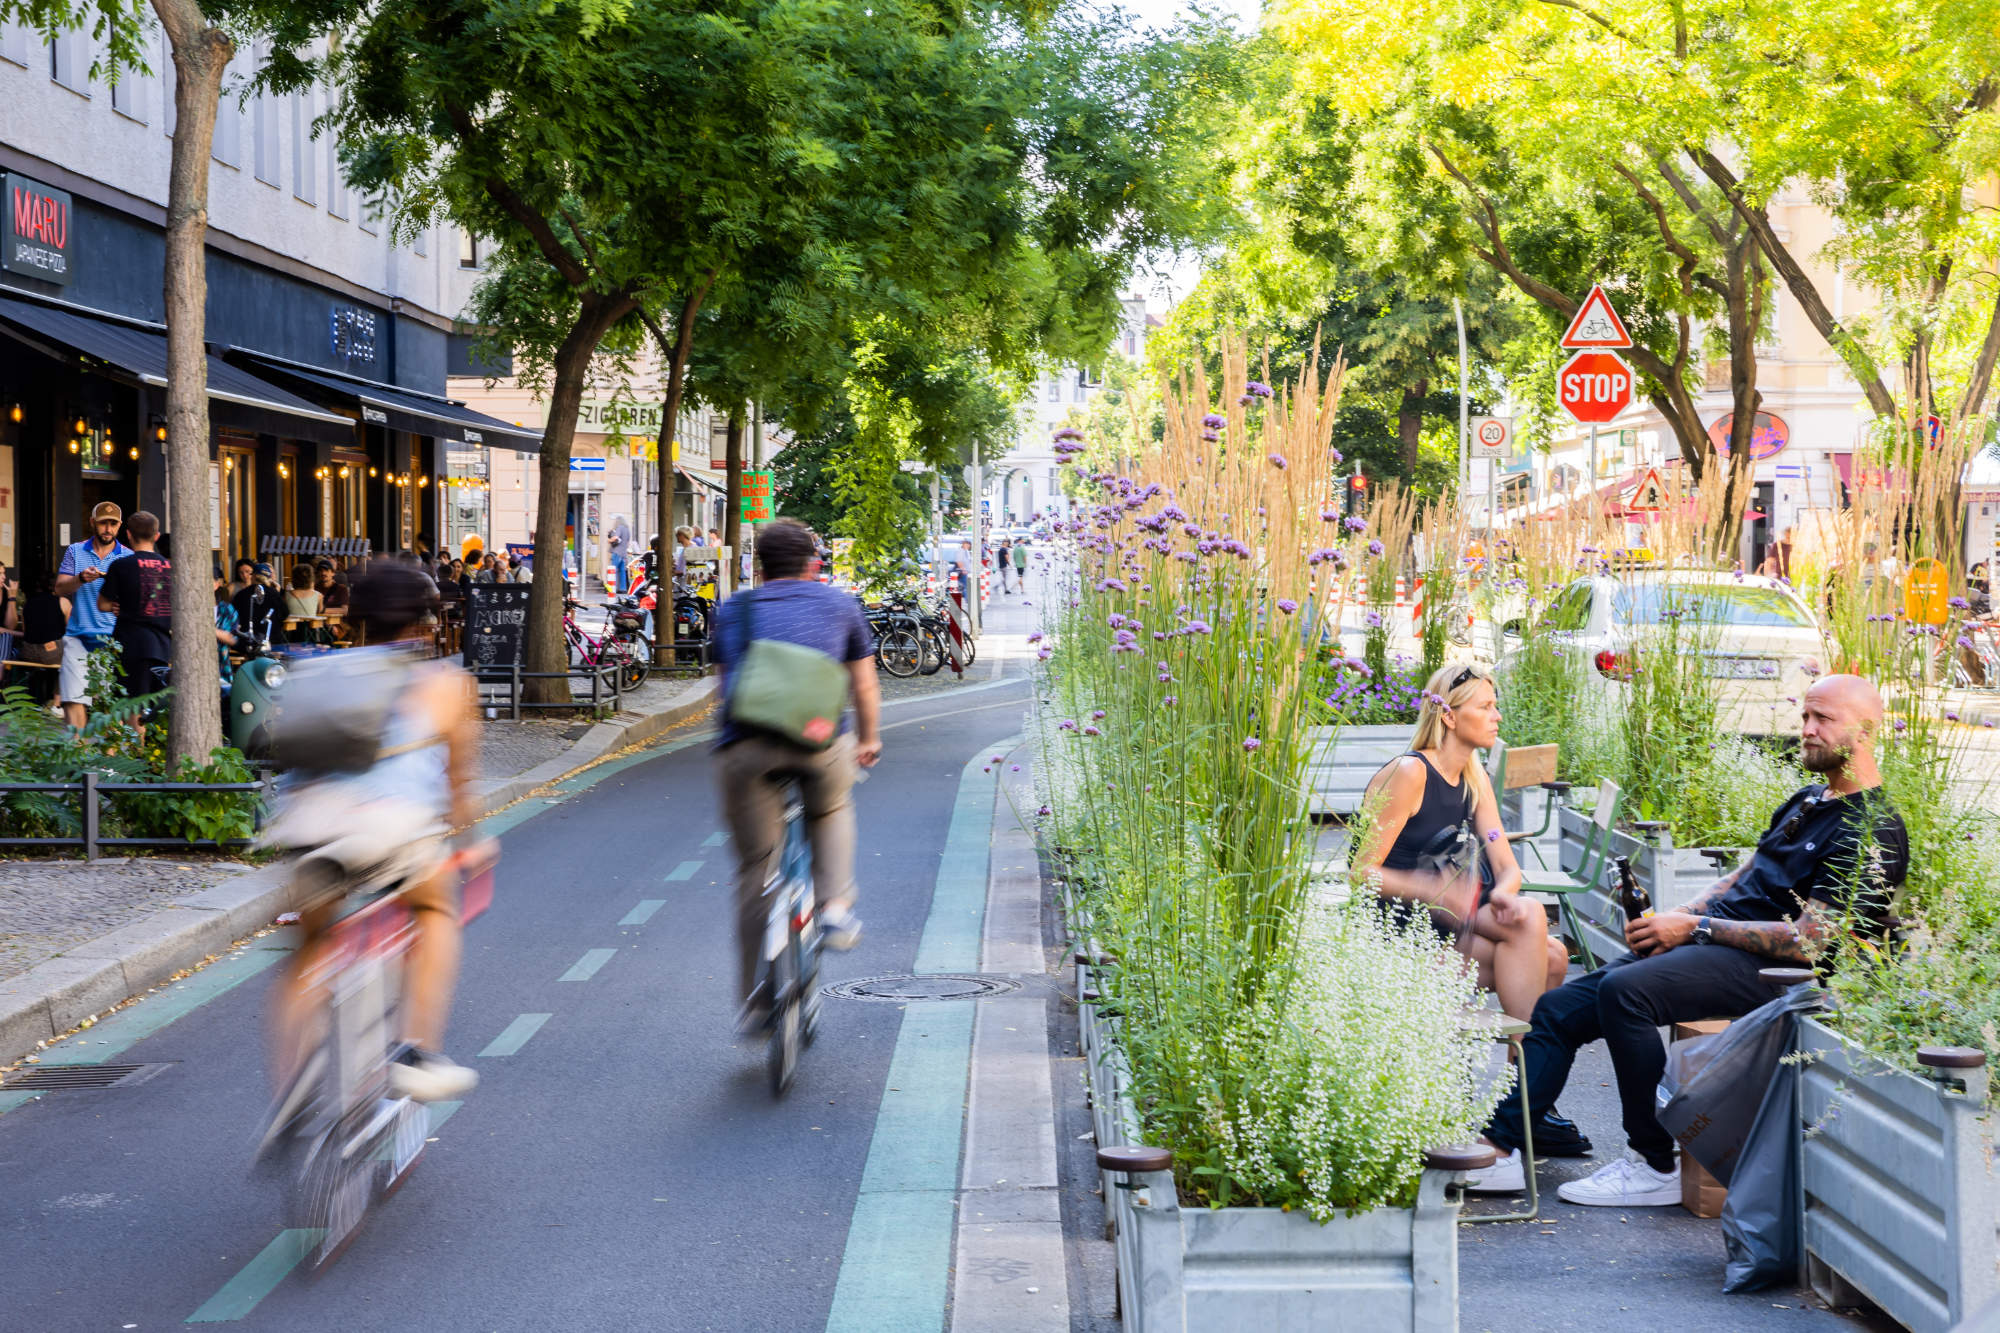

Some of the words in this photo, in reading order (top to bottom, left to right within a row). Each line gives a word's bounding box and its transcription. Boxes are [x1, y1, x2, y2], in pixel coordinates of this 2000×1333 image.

[14, 185, 67, 249] MARU
[1564, 373, 1627, 403] STOP
[1485, 427, 1500, 440] 20
[1481, 447, 1503, 456] ZONE
[743, 474, 754, 485] Es
[756, 473, 768, 485] ist
[741, 485, 770, 497] nicht
[751, 498, 763, 507] zu
